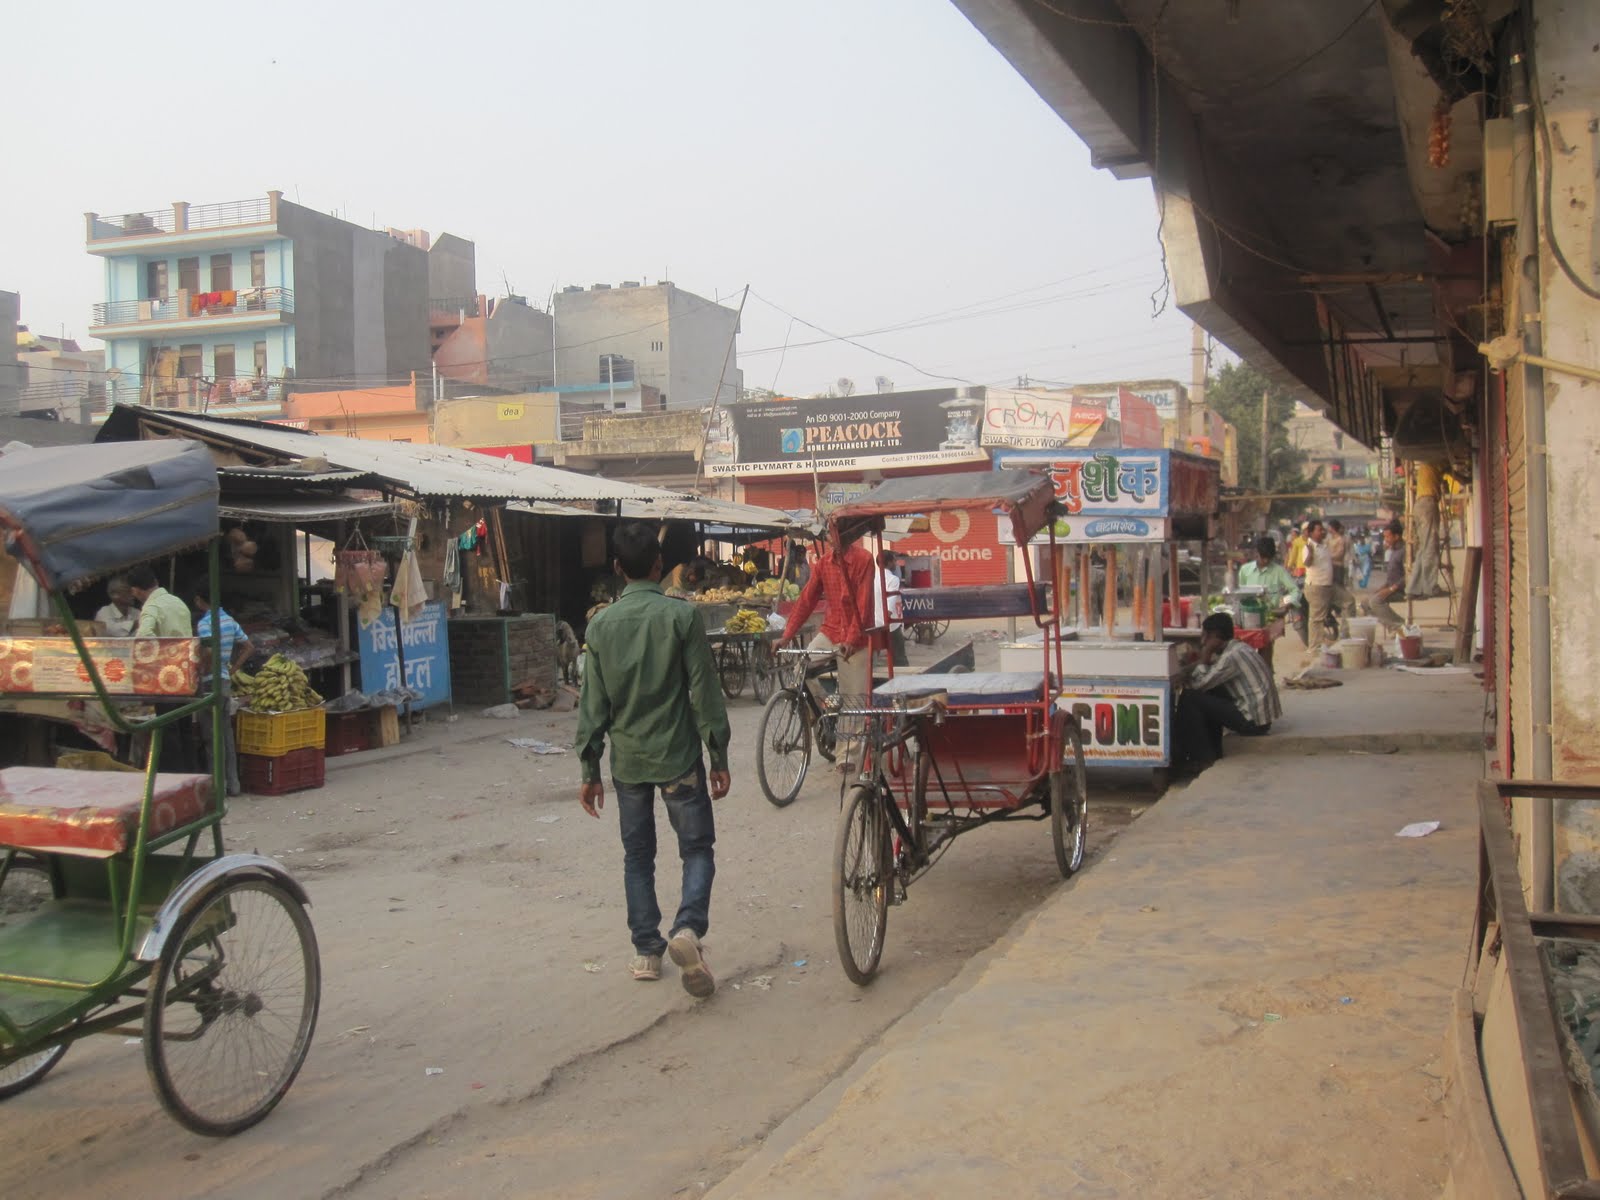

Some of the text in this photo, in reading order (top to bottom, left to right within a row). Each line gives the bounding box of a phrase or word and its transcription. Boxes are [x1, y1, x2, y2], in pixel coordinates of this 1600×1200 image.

[806, 410, 900, 424] An ISO 9001-2000 Company
[986, 402, 1065, 432] CROMA
[805, 420, 902, 444] PEACOCK
[806, 438, 902, 452] HOME APPLIANCES PVT. LTD.
[984, 435, 1066, 449] SWASTIK PLYWOO
[712, 463, 751, 473] SWASTIC
[753, 462, 793, 472] PLYMART
[805, 458, 857, 469] HARDWARE
[907, 545, 993, 561] vodafone
